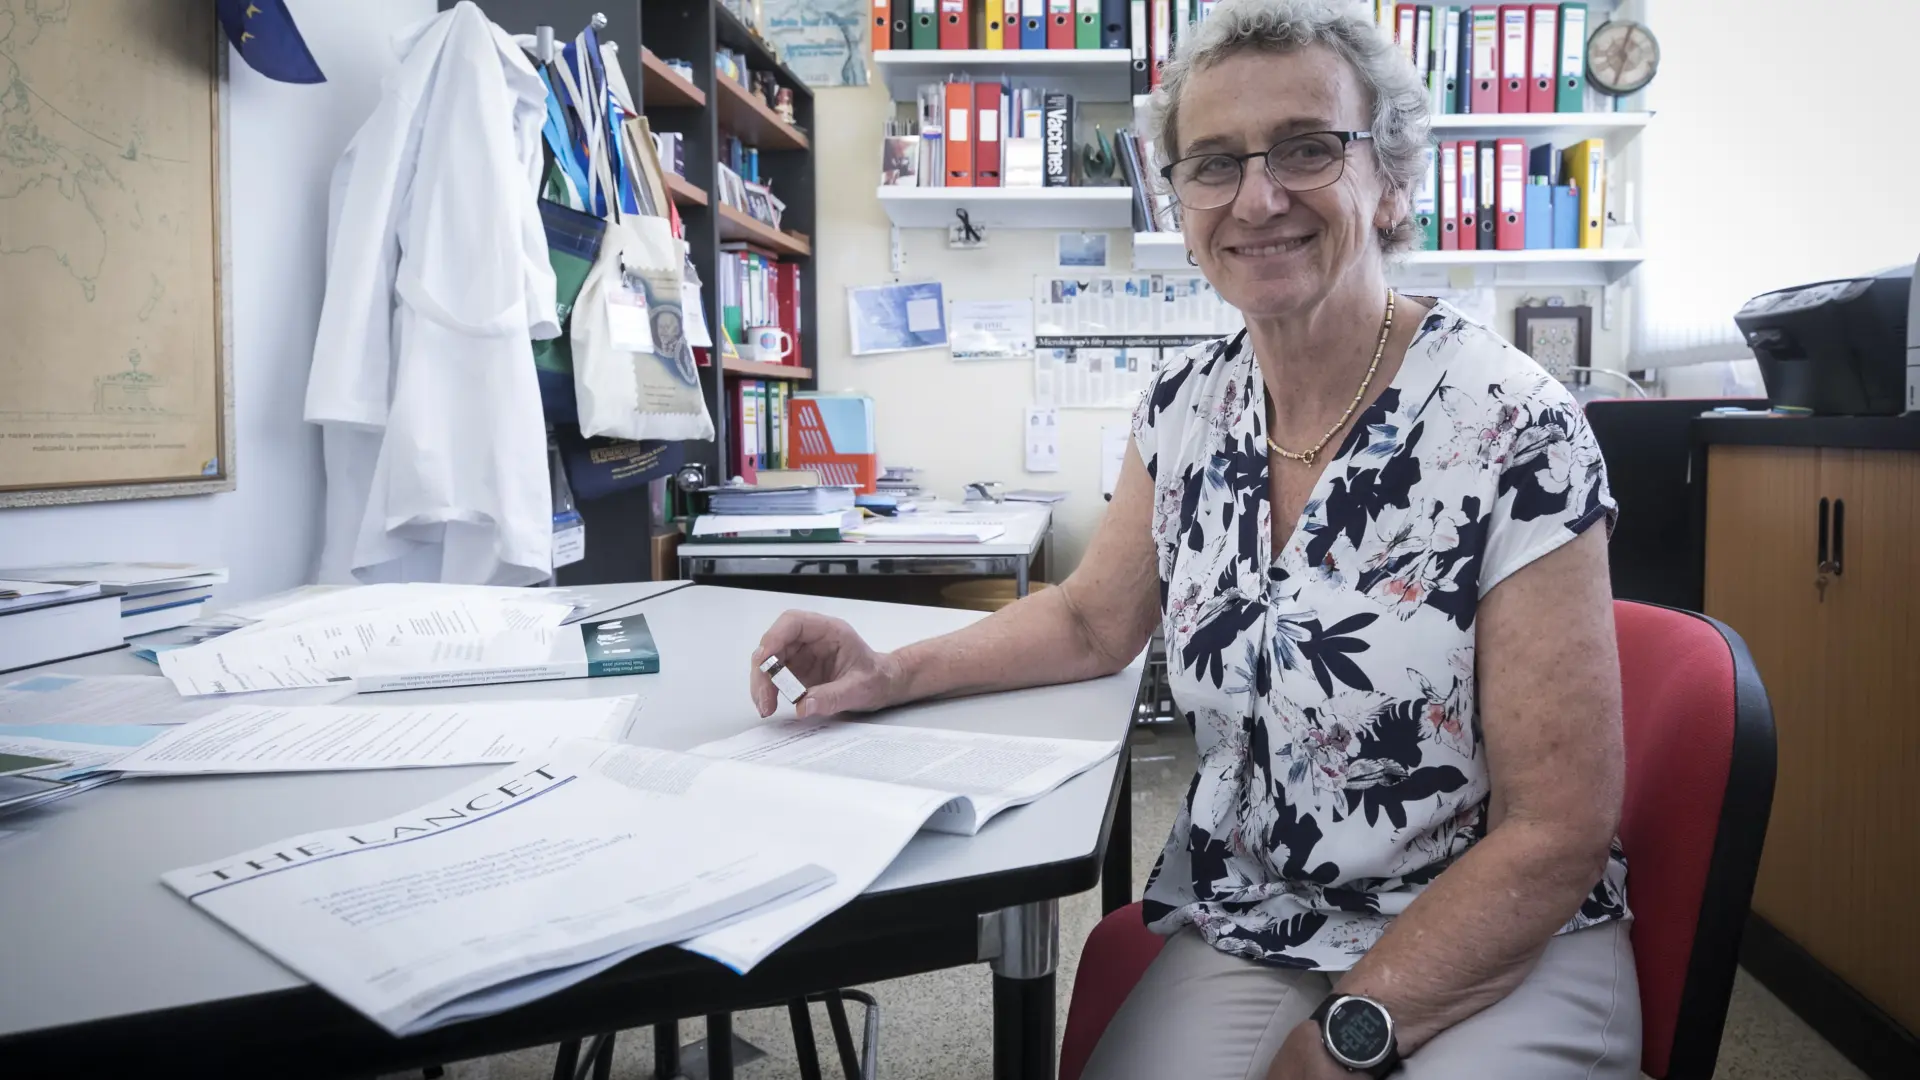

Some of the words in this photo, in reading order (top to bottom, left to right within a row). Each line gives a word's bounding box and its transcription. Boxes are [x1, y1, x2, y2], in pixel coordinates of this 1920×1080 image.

[1047, 109, 1067, 175] Vaccines
[1038, 337, 1090, 347] Microbiology's
[1091, 337, 1105, 347] fifty
[1106, 338, 1124, 346] most
[1125, 336, 1159, 347] significant
[1160, 337, 1182, 345] events
[195, 842, 335, 880] THE
[348, 763, 556, 845] LANCET
